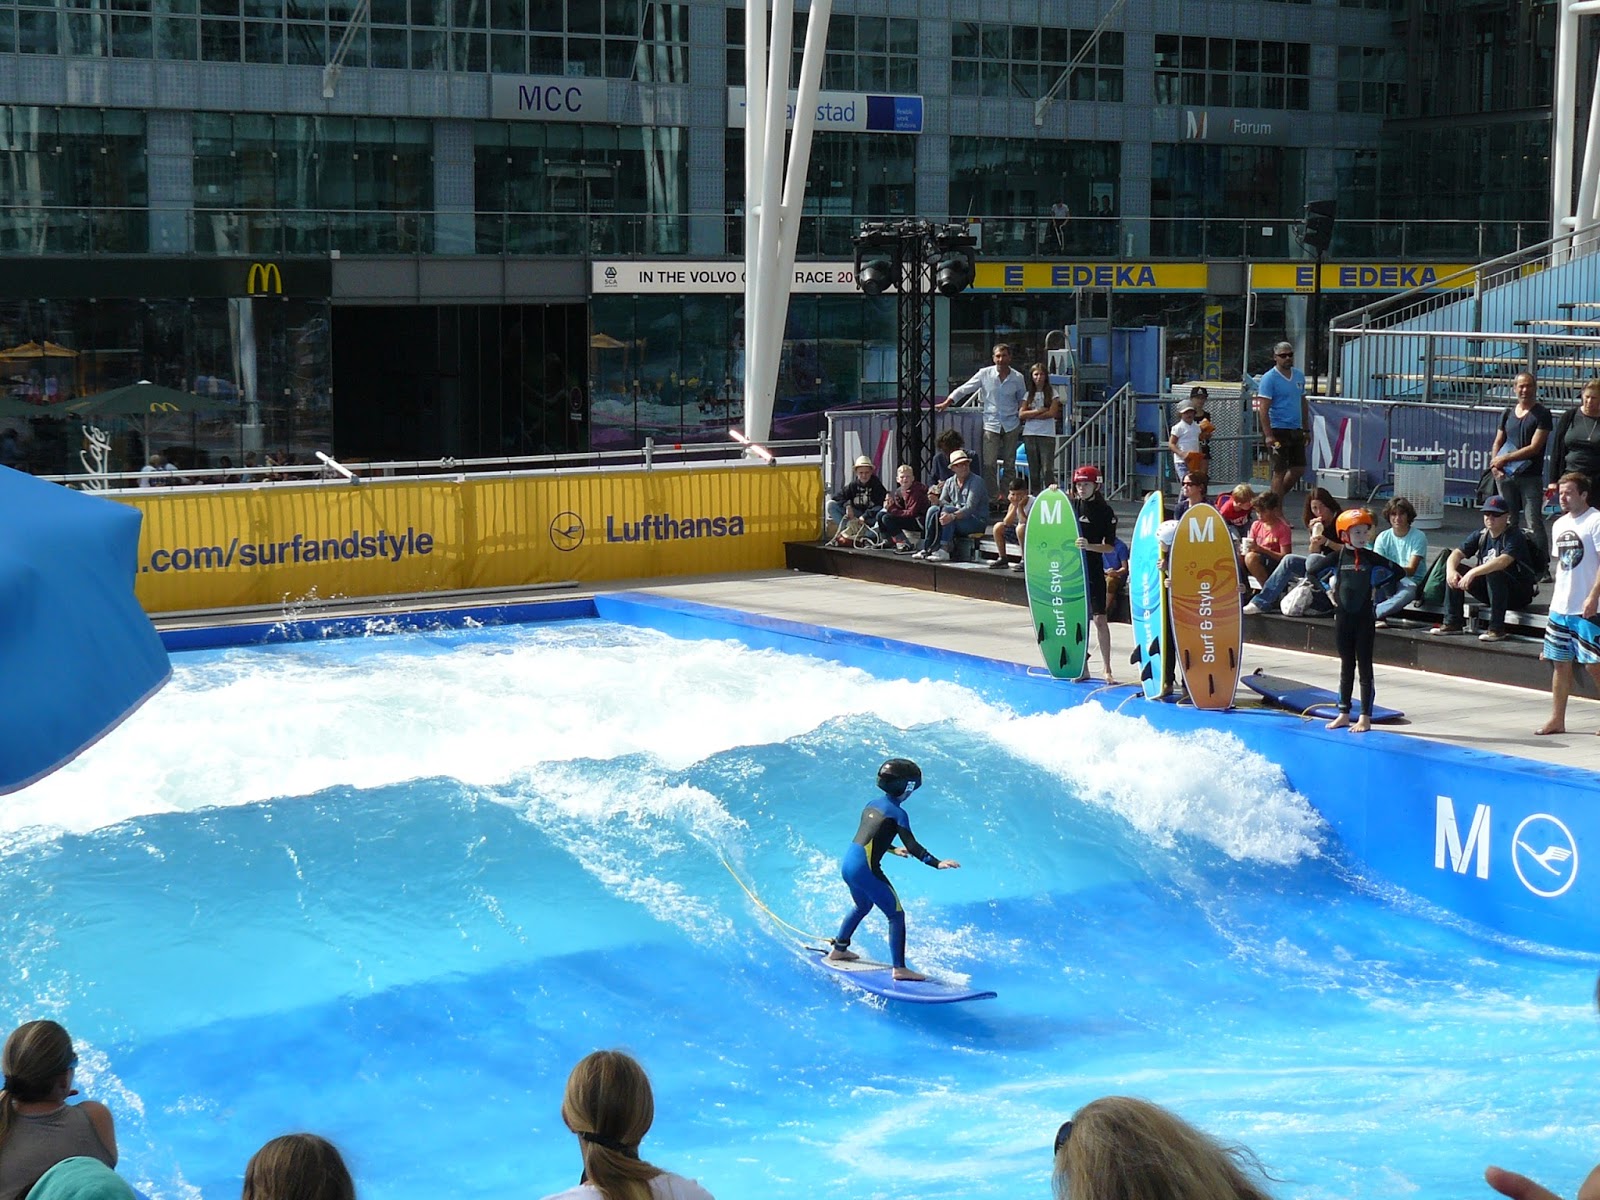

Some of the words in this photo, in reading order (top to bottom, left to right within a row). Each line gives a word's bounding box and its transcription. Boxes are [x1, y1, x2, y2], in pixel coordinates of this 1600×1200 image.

[518, 85, 582, 112] MCC
[639, 271, 653, 283] IN
[657, 271, 686, 283] THE
[690, 271, 737, 283] VOLVO
[795, 271, 833, 283] RACE
[1051, 265, 1157, 287] EDEKA
[1339, 267, 1437, 287] EDEKA
[1040, 500, 1062, 525] M
[606, 513, 744, 543] Lufthansa
[1188, 516, 1215, 543] M
[1049, 560, 1062, 593] Style
[1052, 597, 1063, 607] &
[1197, 582, 1215, 617] Style
[1052, 609, 1067, 637] Surf
[1200, 618, 1213, 630] &
[1200, 635, 1215, 663] Surf
[1434, 795, 1491, 880] M
